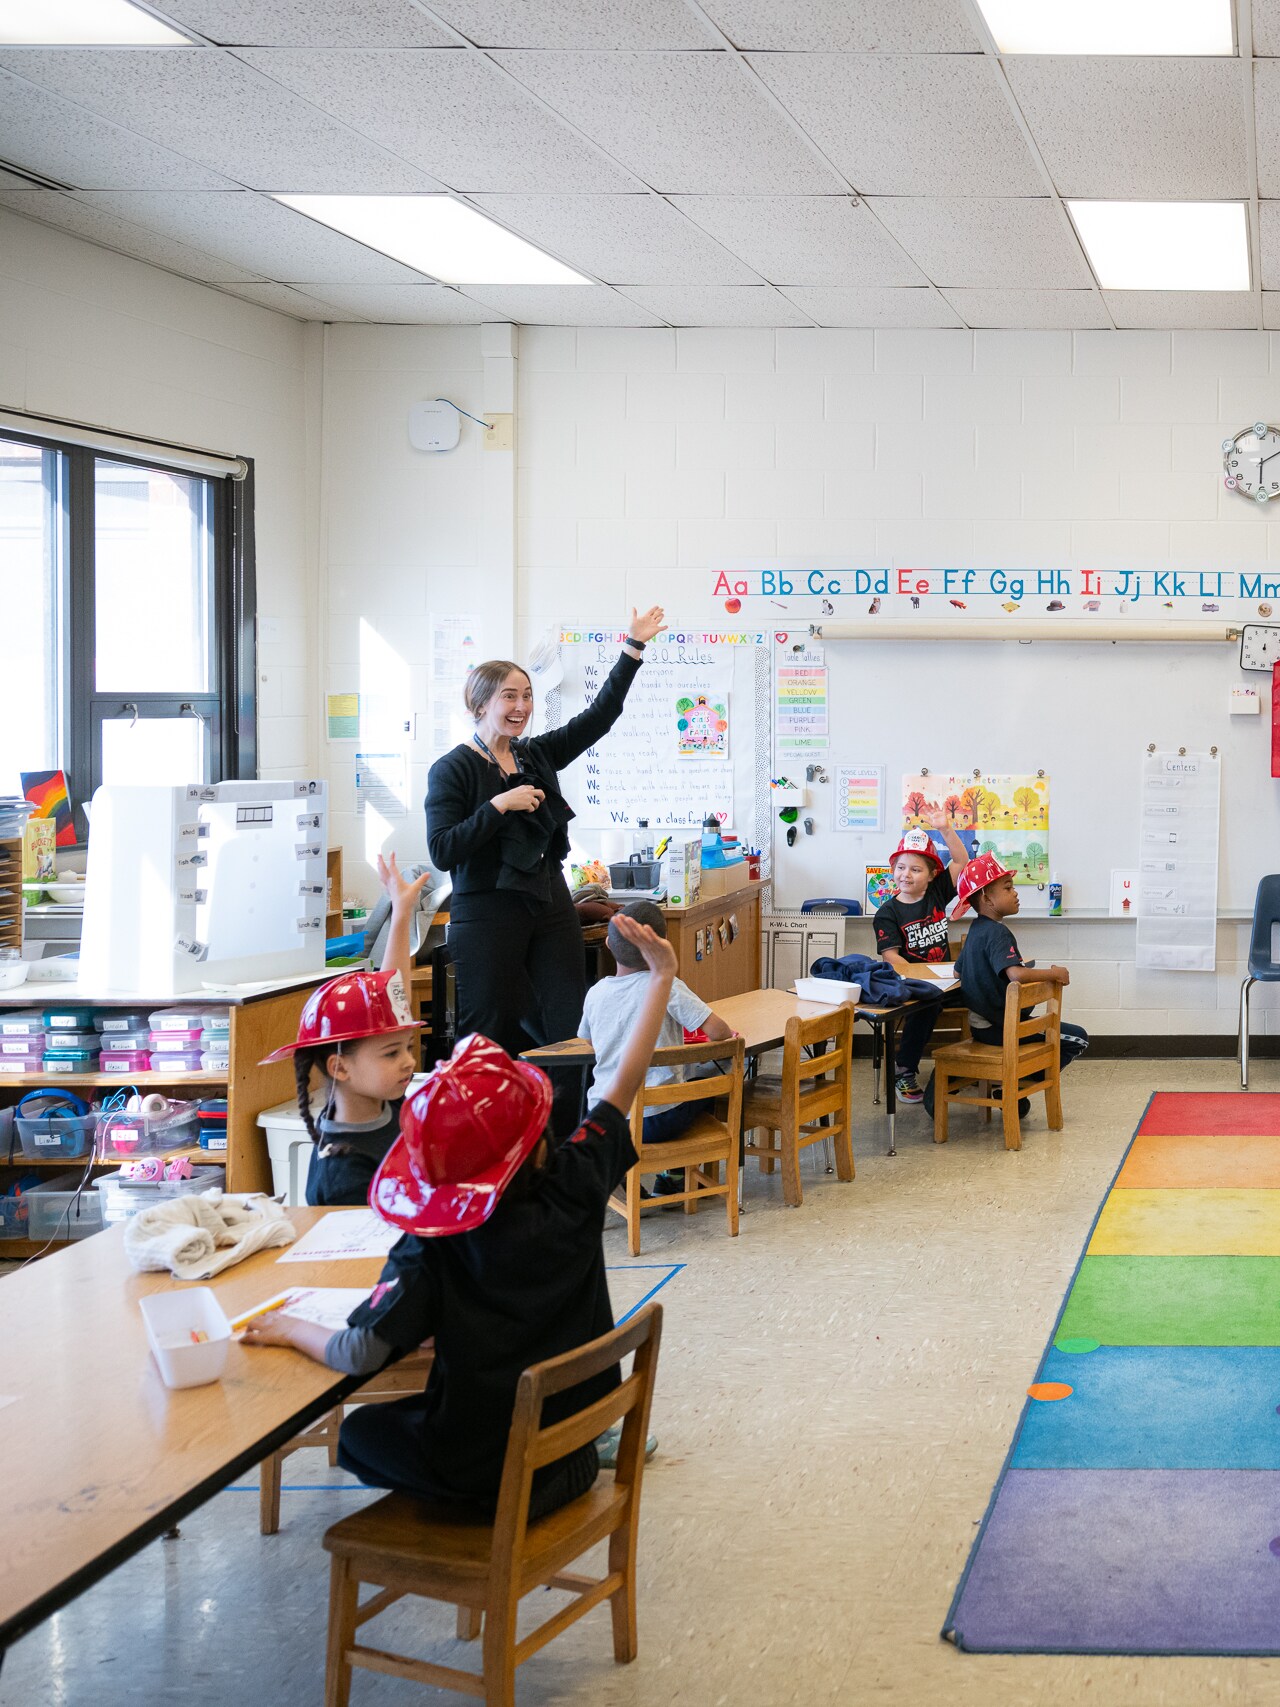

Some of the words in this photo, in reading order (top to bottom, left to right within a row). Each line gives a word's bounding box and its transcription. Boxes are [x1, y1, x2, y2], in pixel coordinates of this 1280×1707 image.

[715, 572, 748, 596] Aa
[762, 571, 793, 596] Bb
[807, 571, 840, 596] Cc
[856, 570, 888, 595] Dd
[898, 570, 929, 595] Ee
[944, 570, 976, 595] Ff
[990, 570, 1024, 601] Gg
[1038, 571, 1070, 595] Hh
[1081, 571, 1101, 596] Ii
[1115, 571, 1140, 603] Jj
[1154, 572, 1184, 597] Kk
[1200, 573, 1222, 598] Ll
[678, 646, 713, 662] Rules
[585, 666, 598, 676] We
[585, 681, 598, 690] We
[587, 747, 600, 757] We
[587, 765, 600, 775] We
[1166, 760, 1196, 771] Centers
[587, 780, 600, 790] We
[949, 776, 972, 784] Move
[587, 795, 600, 805] We
[611, 811, 629, 824] We
[666, 812, 687, 825] class
[1123, 879, 1130, 889] u
[905, 922, 921, 932] TAKE
[907, 918, 949, 942] CHARGE
[908, 941, 917, 949] OF
